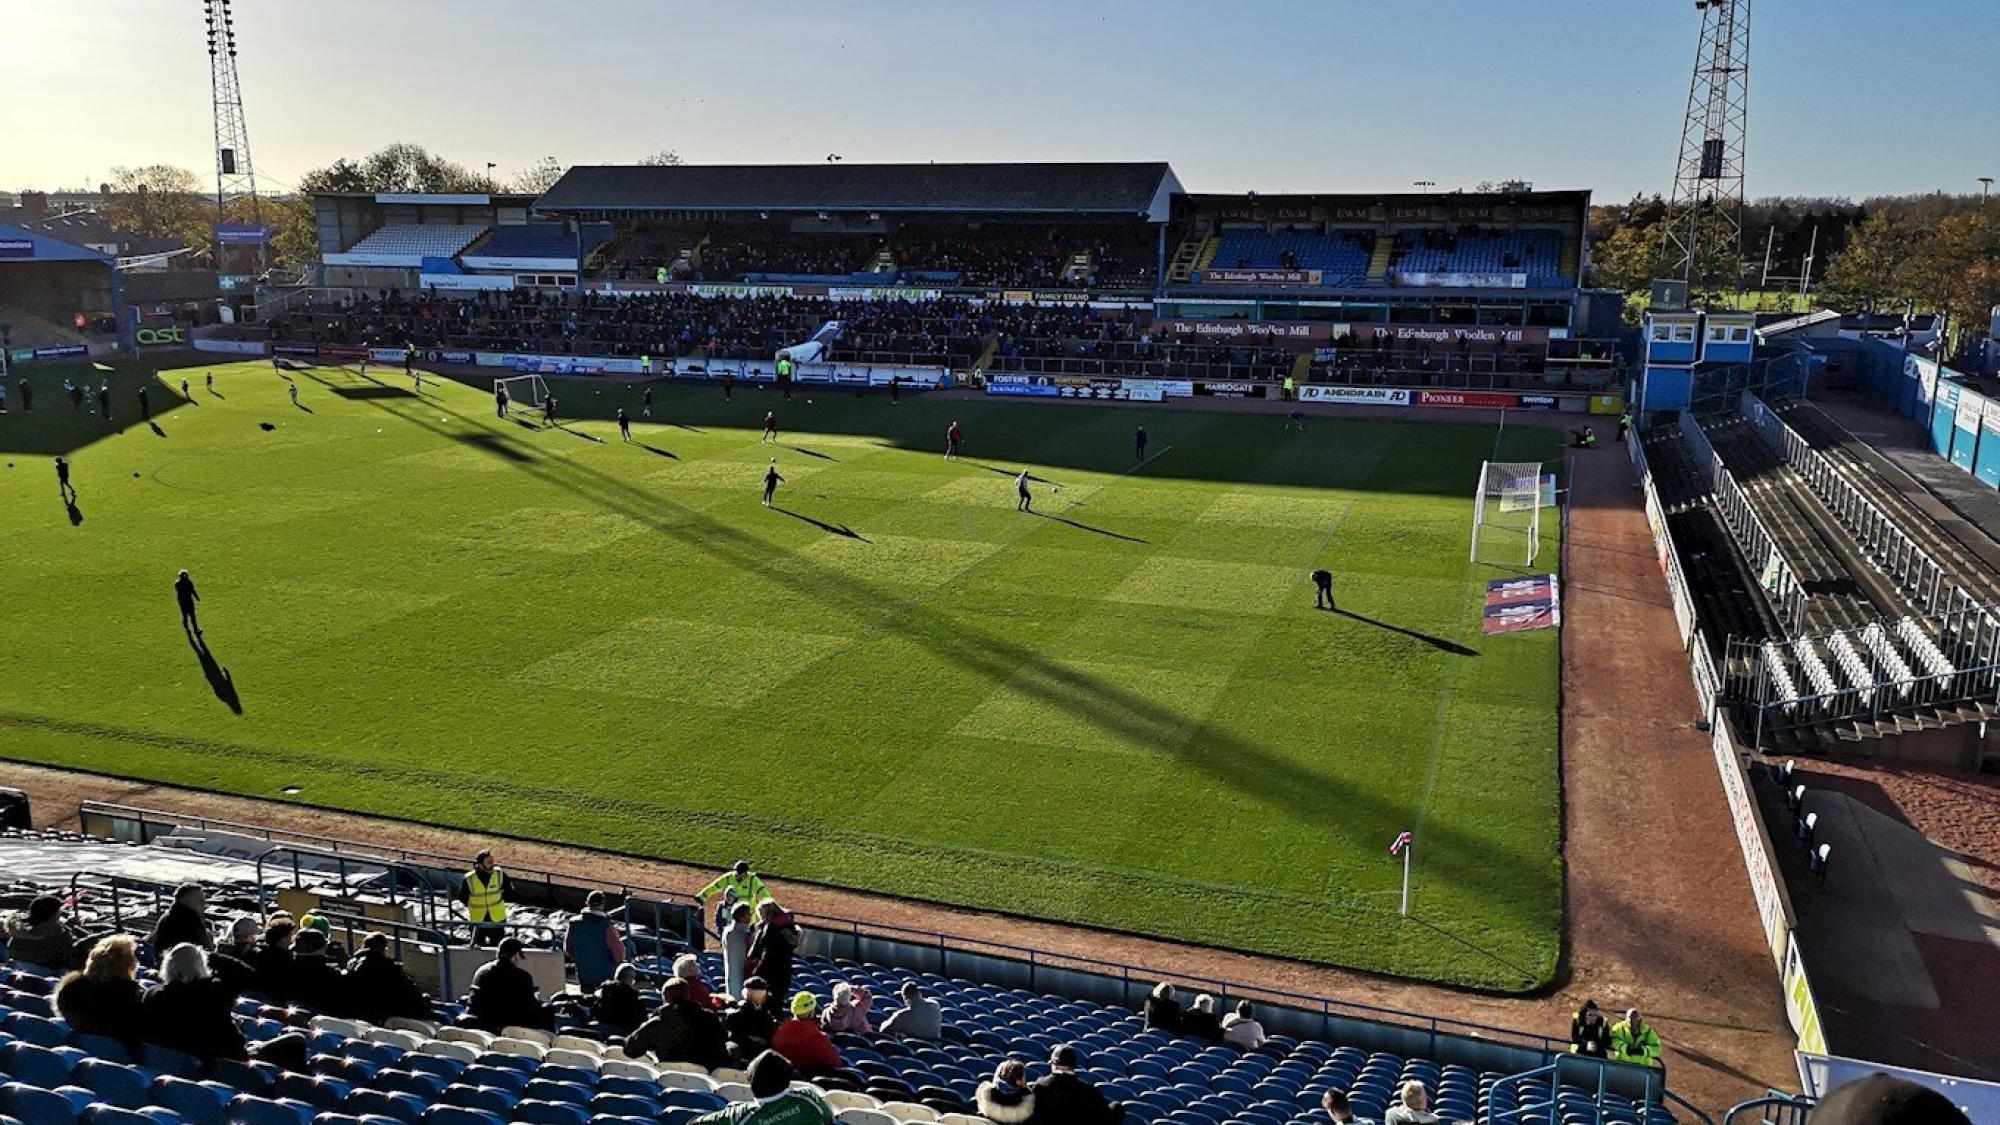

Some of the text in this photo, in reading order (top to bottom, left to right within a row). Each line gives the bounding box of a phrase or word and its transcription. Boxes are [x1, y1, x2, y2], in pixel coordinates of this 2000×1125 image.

[1210, 271, 1301, 282] The Edinburgh Woollen Mill
[1034, 293, 1062, 301] FAMILY
[1063, 293, 1089, 301] STAND
[1174, 322, 1192, 334] The
[1195, 323, 1243, 337] Edinburgh
[1289, 325, 1311, 337] Mill
[1204, 382, 1254, 393] HARROGATE
[1421, 391, 1465, 405] PIONEER
